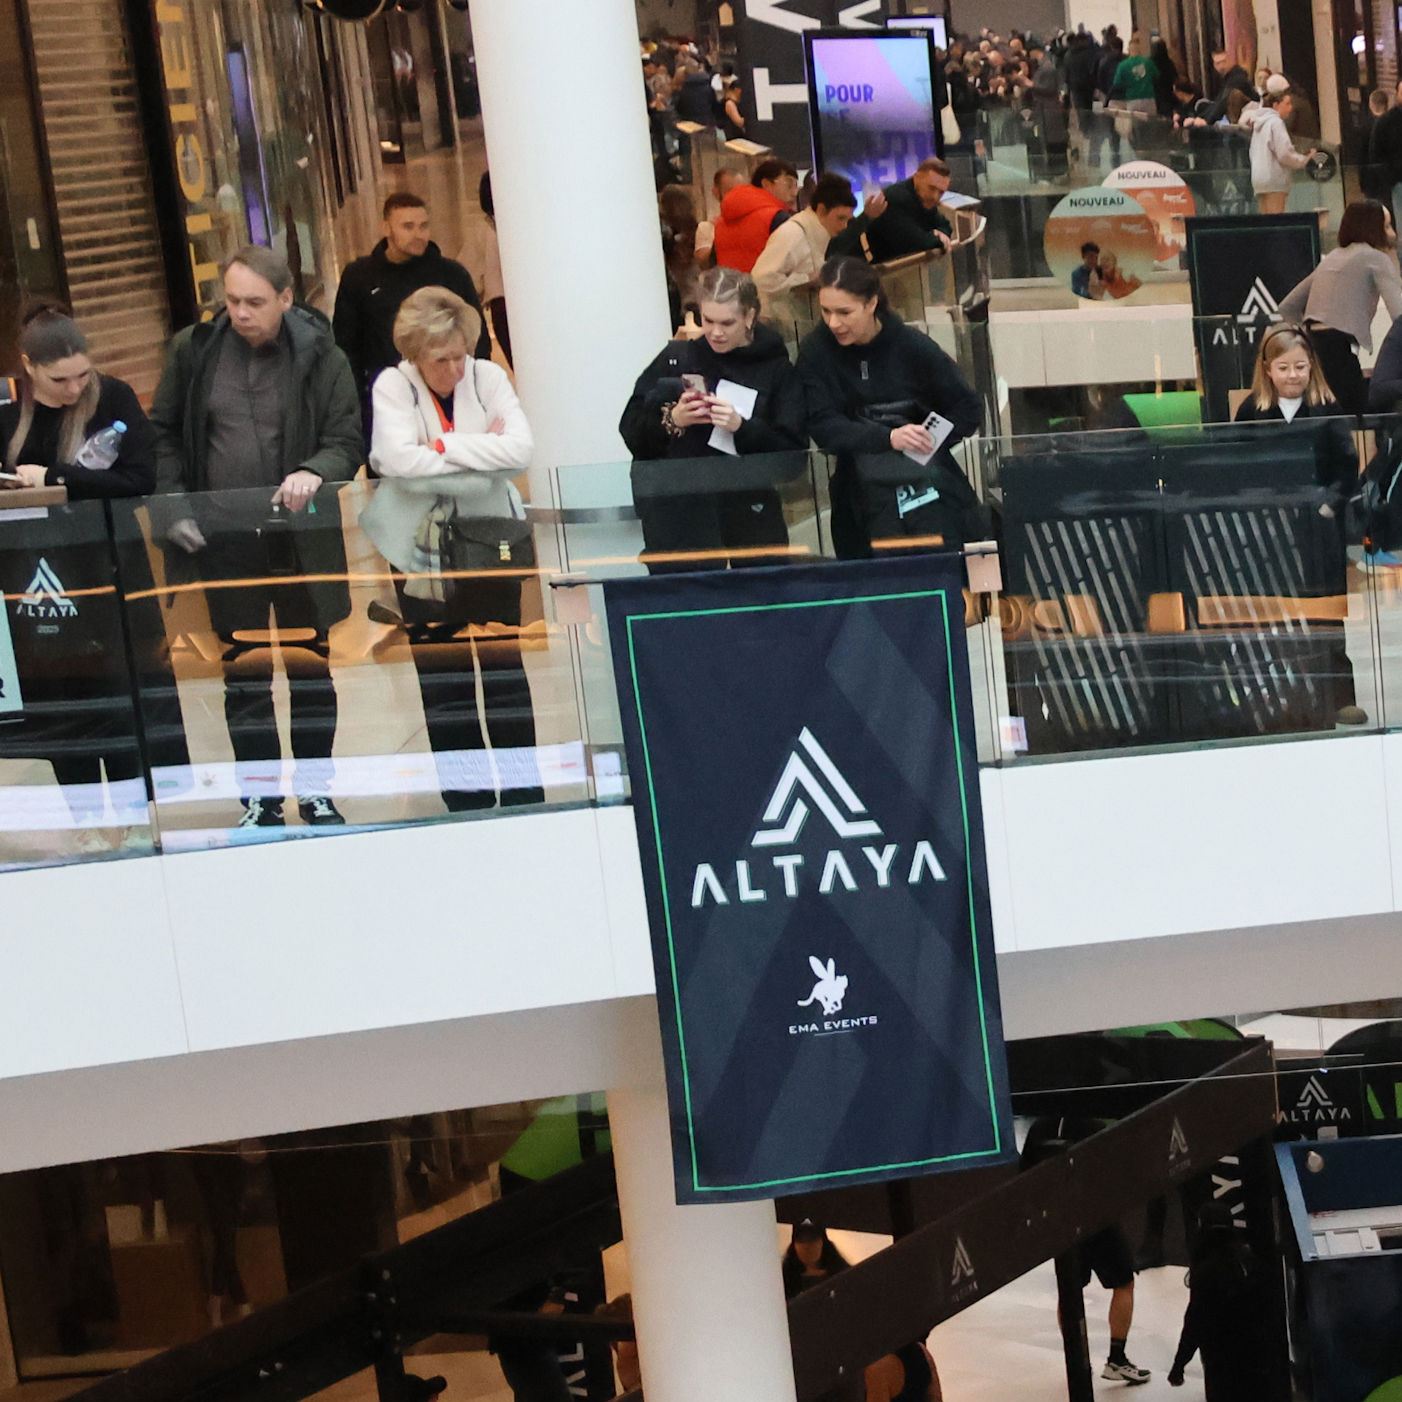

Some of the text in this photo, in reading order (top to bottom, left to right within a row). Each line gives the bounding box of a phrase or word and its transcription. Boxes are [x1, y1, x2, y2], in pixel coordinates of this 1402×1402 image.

[825, 84, 874, 103] POUR
[1117, 170, 1167, 180] NOUVEAU
[1069, 196, 1125, 208] NOUVEAU
[691, 840, 948, 908] ALTAYA
[789, 1015, 878, 1034] EMA EVENTS
[1277, 1107, 1351, 1124] ALTAYA
